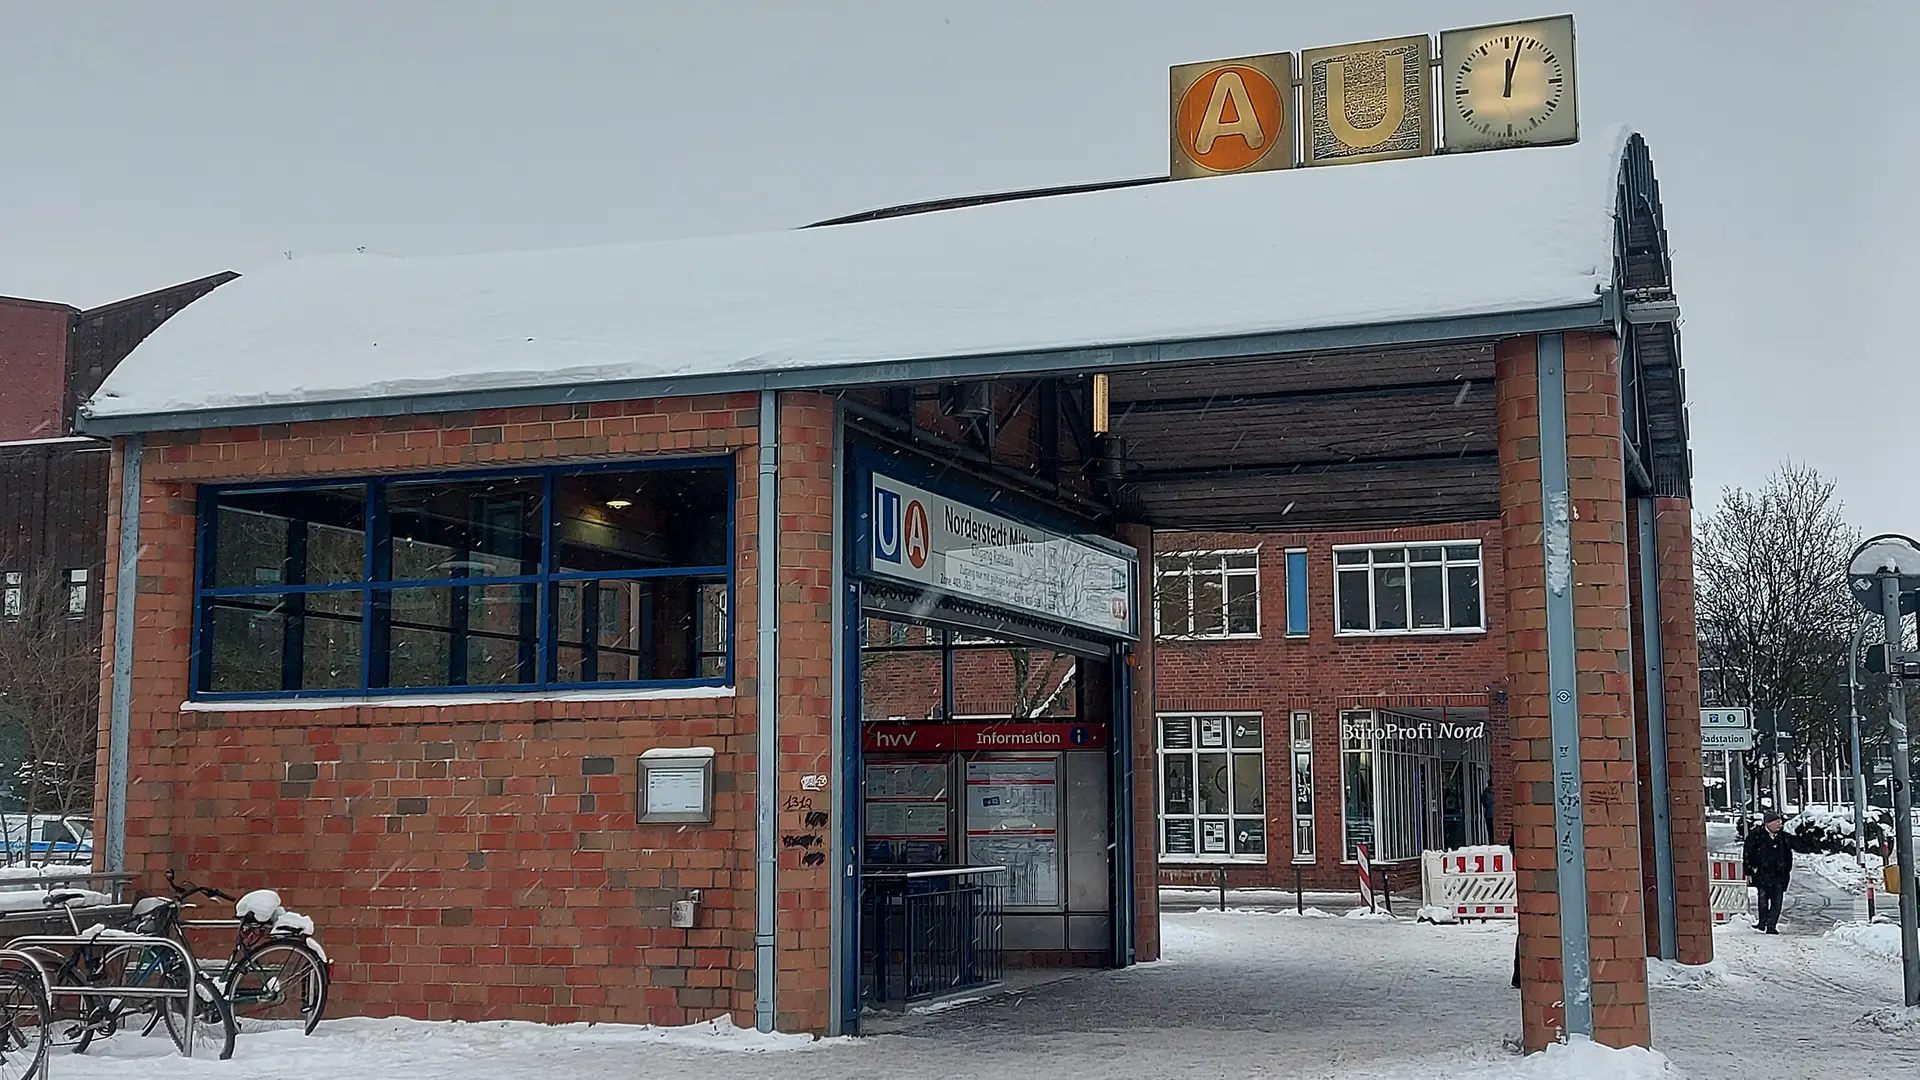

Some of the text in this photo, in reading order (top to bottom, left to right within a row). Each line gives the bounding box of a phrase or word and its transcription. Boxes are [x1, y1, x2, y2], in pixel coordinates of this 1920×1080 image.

[1194, 53, 1405, 155] A U
[878, 492, 926, 558] U A
[945, 505, 1034, 558] Norderstedt Mitte
[877, 731, 916, 747] hvv
[976, 731, 1060, 744] Information
[1342, 722, 1485, 740] BüroProfi Nord
[1701, 734, 1744, 743] Radstation
[783, 795, 812, 810] 1312
